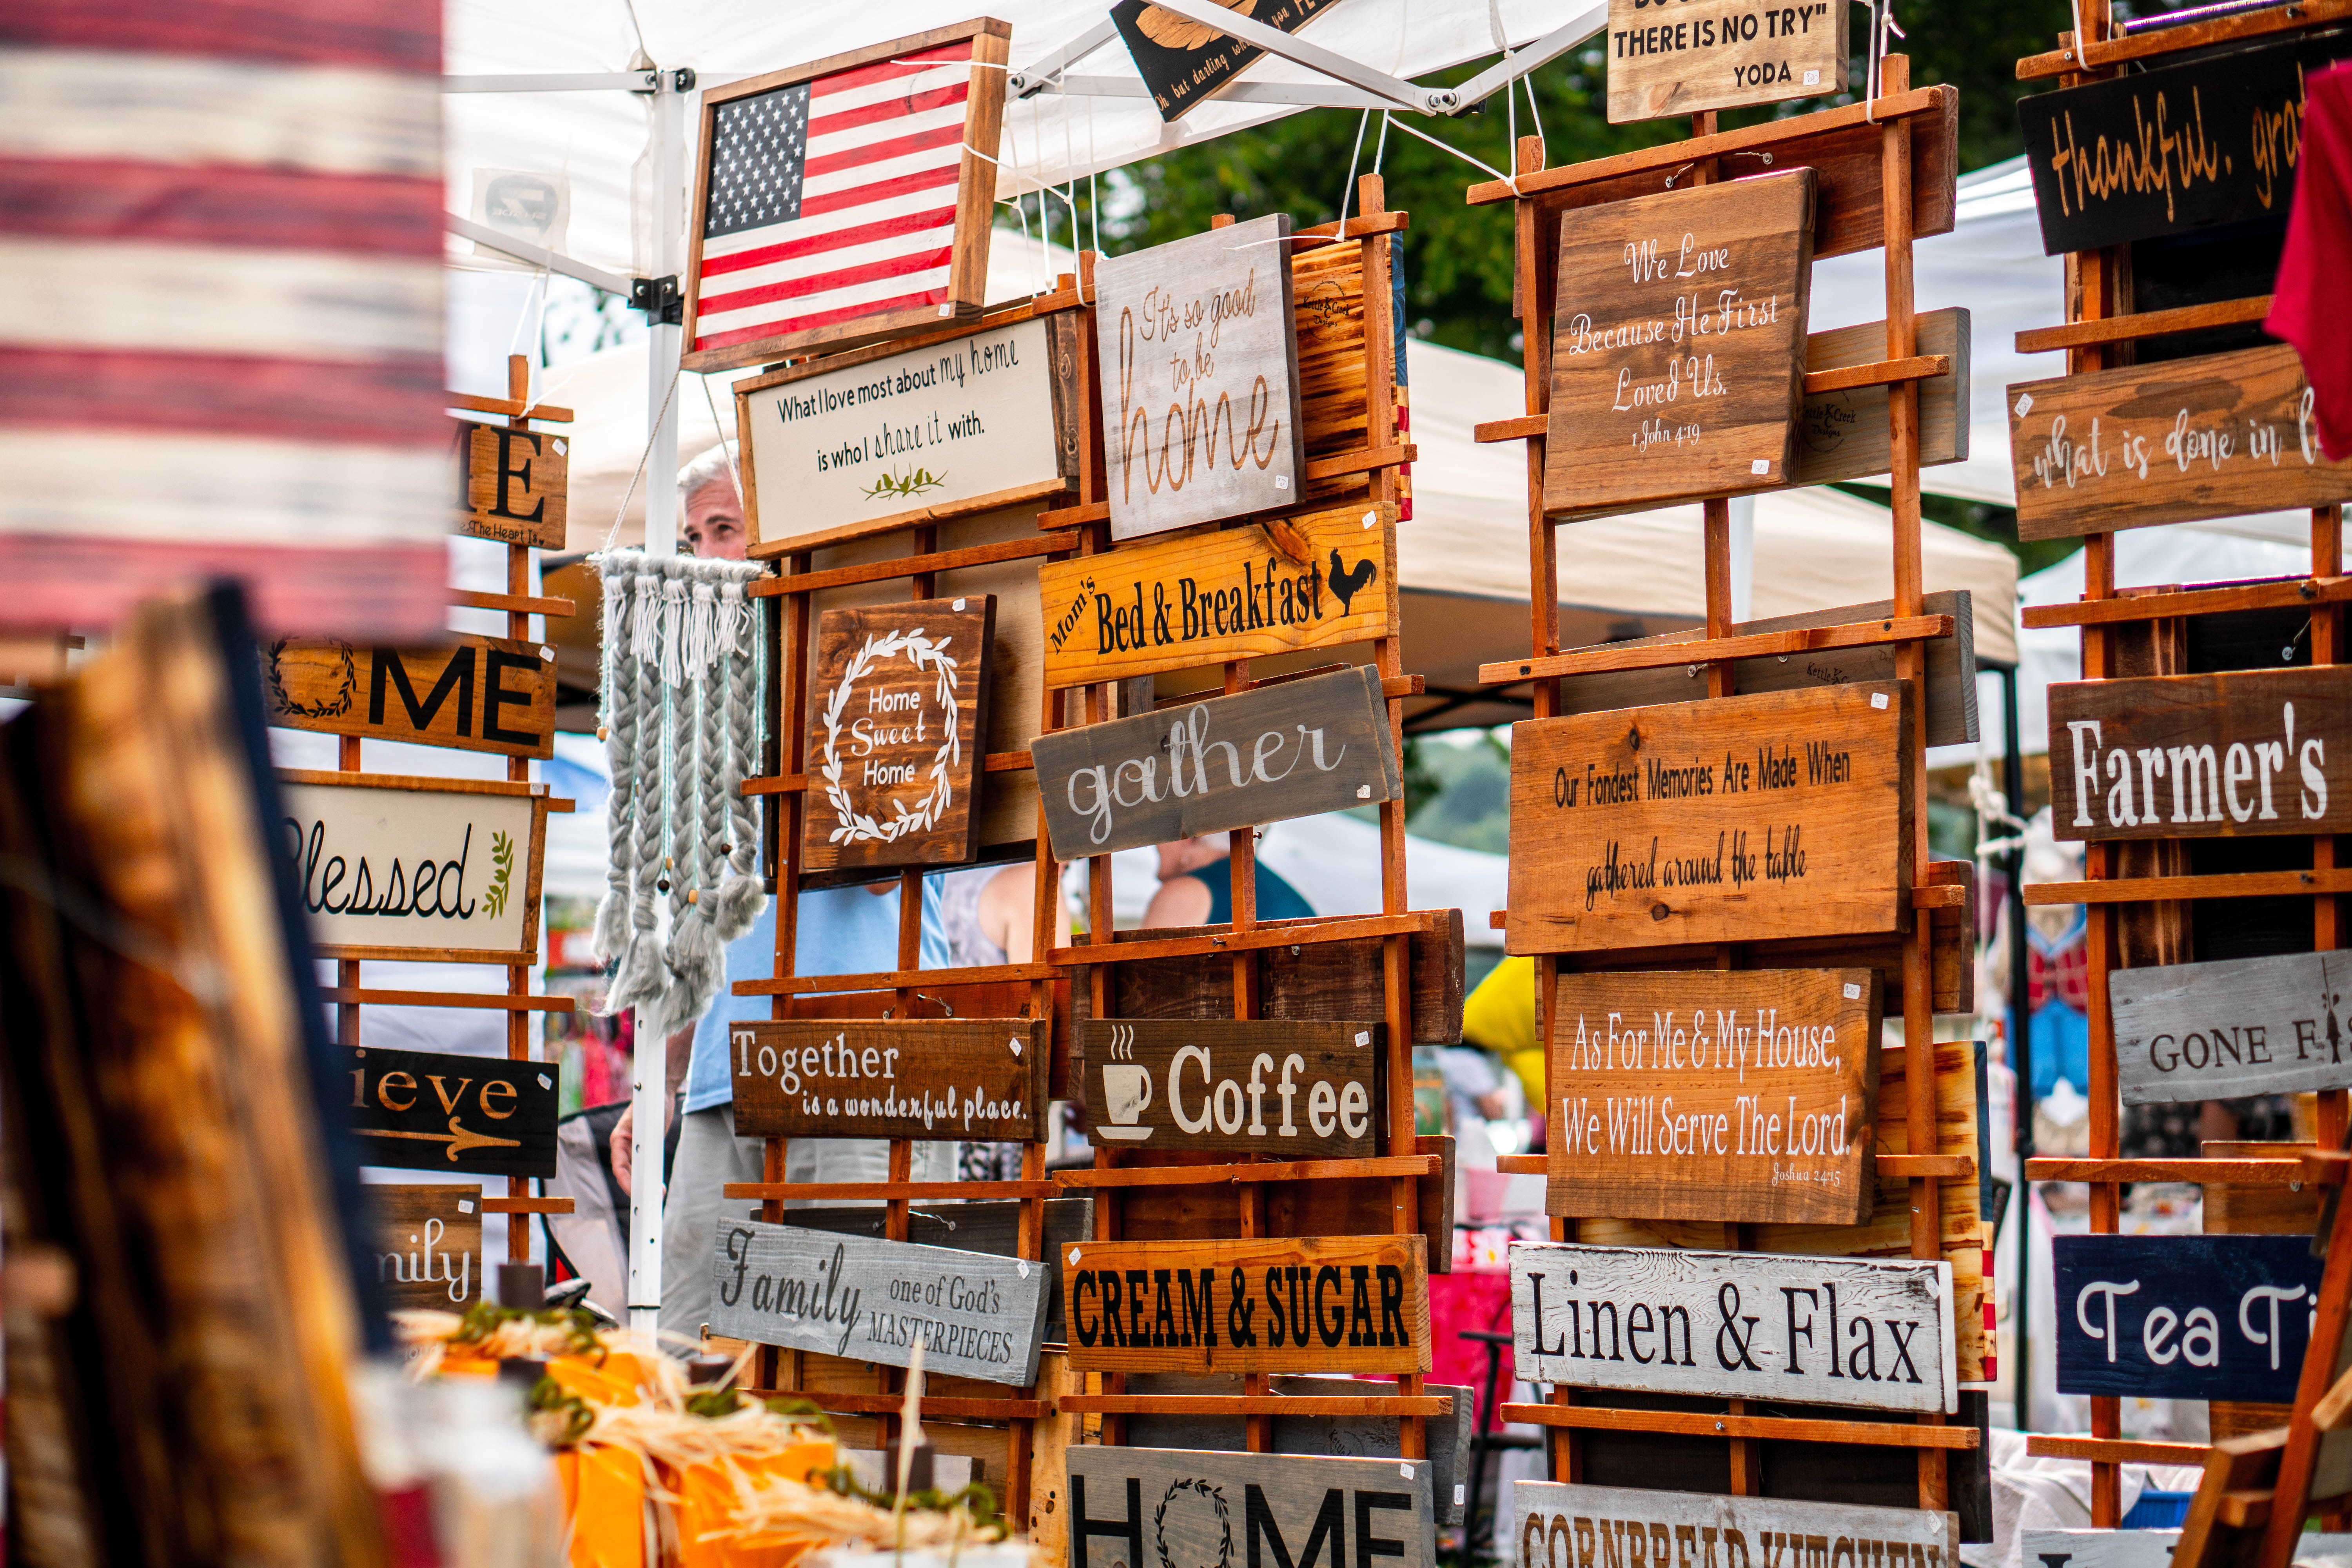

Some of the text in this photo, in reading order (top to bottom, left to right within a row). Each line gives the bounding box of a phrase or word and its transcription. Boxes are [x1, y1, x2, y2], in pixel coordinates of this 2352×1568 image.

[1154, 93, 1170, 112] Oh
[1171, 78, 1191, 99] but
[1192, 53, 1230, 85] darling
[1271, 6, 1290, 31] you
[1614, 2, 1827, 58] THERE IS NO TRY"
[1734, 60, 1792, 88] YODA
[2051, 85, 2232, 223] thankful.
[1624, 232, 1730, 283] We Love
[1140, 267, 1255, 349] It's so good
[1303, 296, 1324, 311] Kettle
[1332, 301, 1350, 316] Creek
[1313, 315, 1338, 328] Designs
[1568, 288, 1779, 356] Because He First
[777, 338, 1019, 424] What I love most about my home
[1170, 332, 1214, 393] to be
[1611, 353, 1727, 413] Loved Us.
[1120, 305, 1279, 505] home
[1639, 417, 1671, 453] John
[1675, 423, 1700, 448] 4:19
[1834, 408, 1856, 423] Creek
[817, 410, 985, 472] is who I share it with.
[2034, 415, 2109, 488] what
[2123, 430, 2152, 480] is
[2165, 408, 2235, 472] done
[2249, 418, 2283, 467] in
[493, 523, 524, 543] Heart
[527, 529, 538, 544] Is
[1049, 574, 1096, 656] Mom's
[1097, 556, 1323, 655] Bed & Breakfast
[868, 688, 921, 715] Home
[1806, 661, 1831, 682] Kettle
[851, 709, 926, 757] Sweet
[2067, 701, 2327, 828] Farmer's
[863, 760, 915, 786] Home
[1067, 703, 1347, 845] gather
[1554, 739, 1850, 808] Our Fondest Memories Are Made When
[1586, 824, 1807, 912] gathered around the table
[732, 1030, 899, 1096] Together
[1570, 1008, 1840, 1083] As For Me & My House,
[2149, 1025, 2272, 1073] GONE
[347, 1049, 517, 1120] ieve
[802, 1084, 1027, 1132] is a wonderful place.
[1168, 1045, 1368, 1139] Coffee
[1562, 1094, 1851, 1156] We Will Serve The Lord.
[1771, 1161, 1842, 1188] Joshua 24:15
[720, 1227, 1000, 1357] Family one of God's
[1073, 1264, 1410, 1349] CREAM & SUGAR
[2076, 1279, 2220, 1368] Tea
[866, 1311, 1013, 1364] MASTERPIECES
[1527, 1269, 1923, 1385] Linen & Flax
